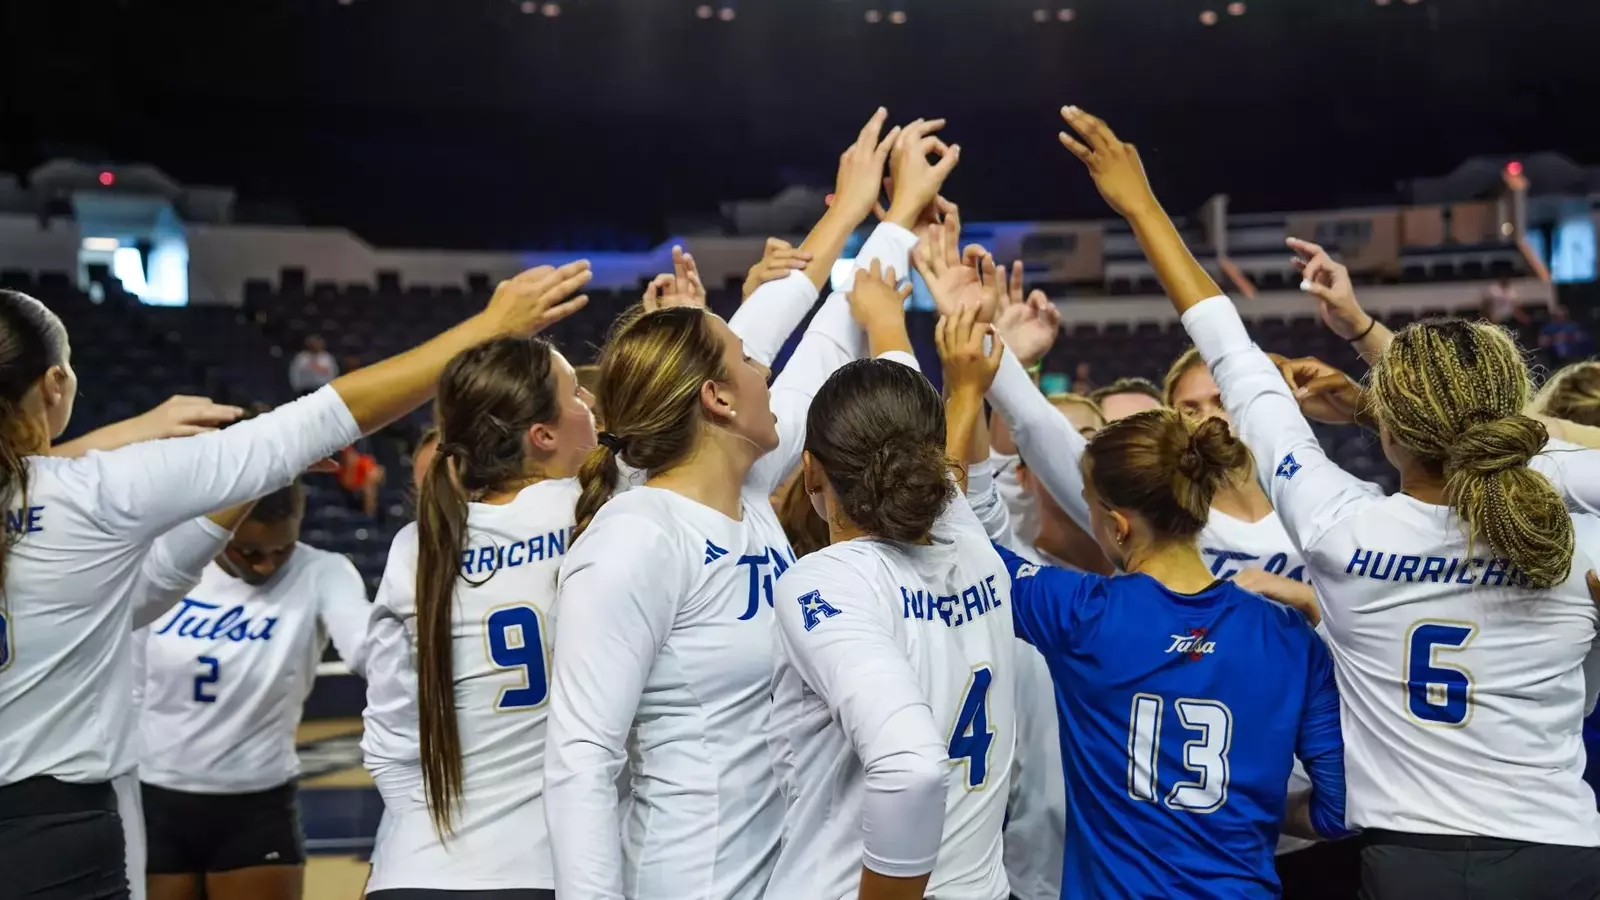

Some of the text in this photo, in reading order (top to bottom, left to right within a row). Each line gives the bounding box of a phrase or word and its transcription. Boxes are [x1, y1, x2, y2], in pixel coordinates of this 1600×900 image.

[155, 598, 278, 641] Tulsa
[483, 602, 550, 713] 9
[1163, 634, 1217, 654] Tulsa
[1405, 618, 1479, 728] 6
[193, 656, 220, 703] 2
[947, 661, 998, 792] 4
[1127, 692, 1234, 814] 13
